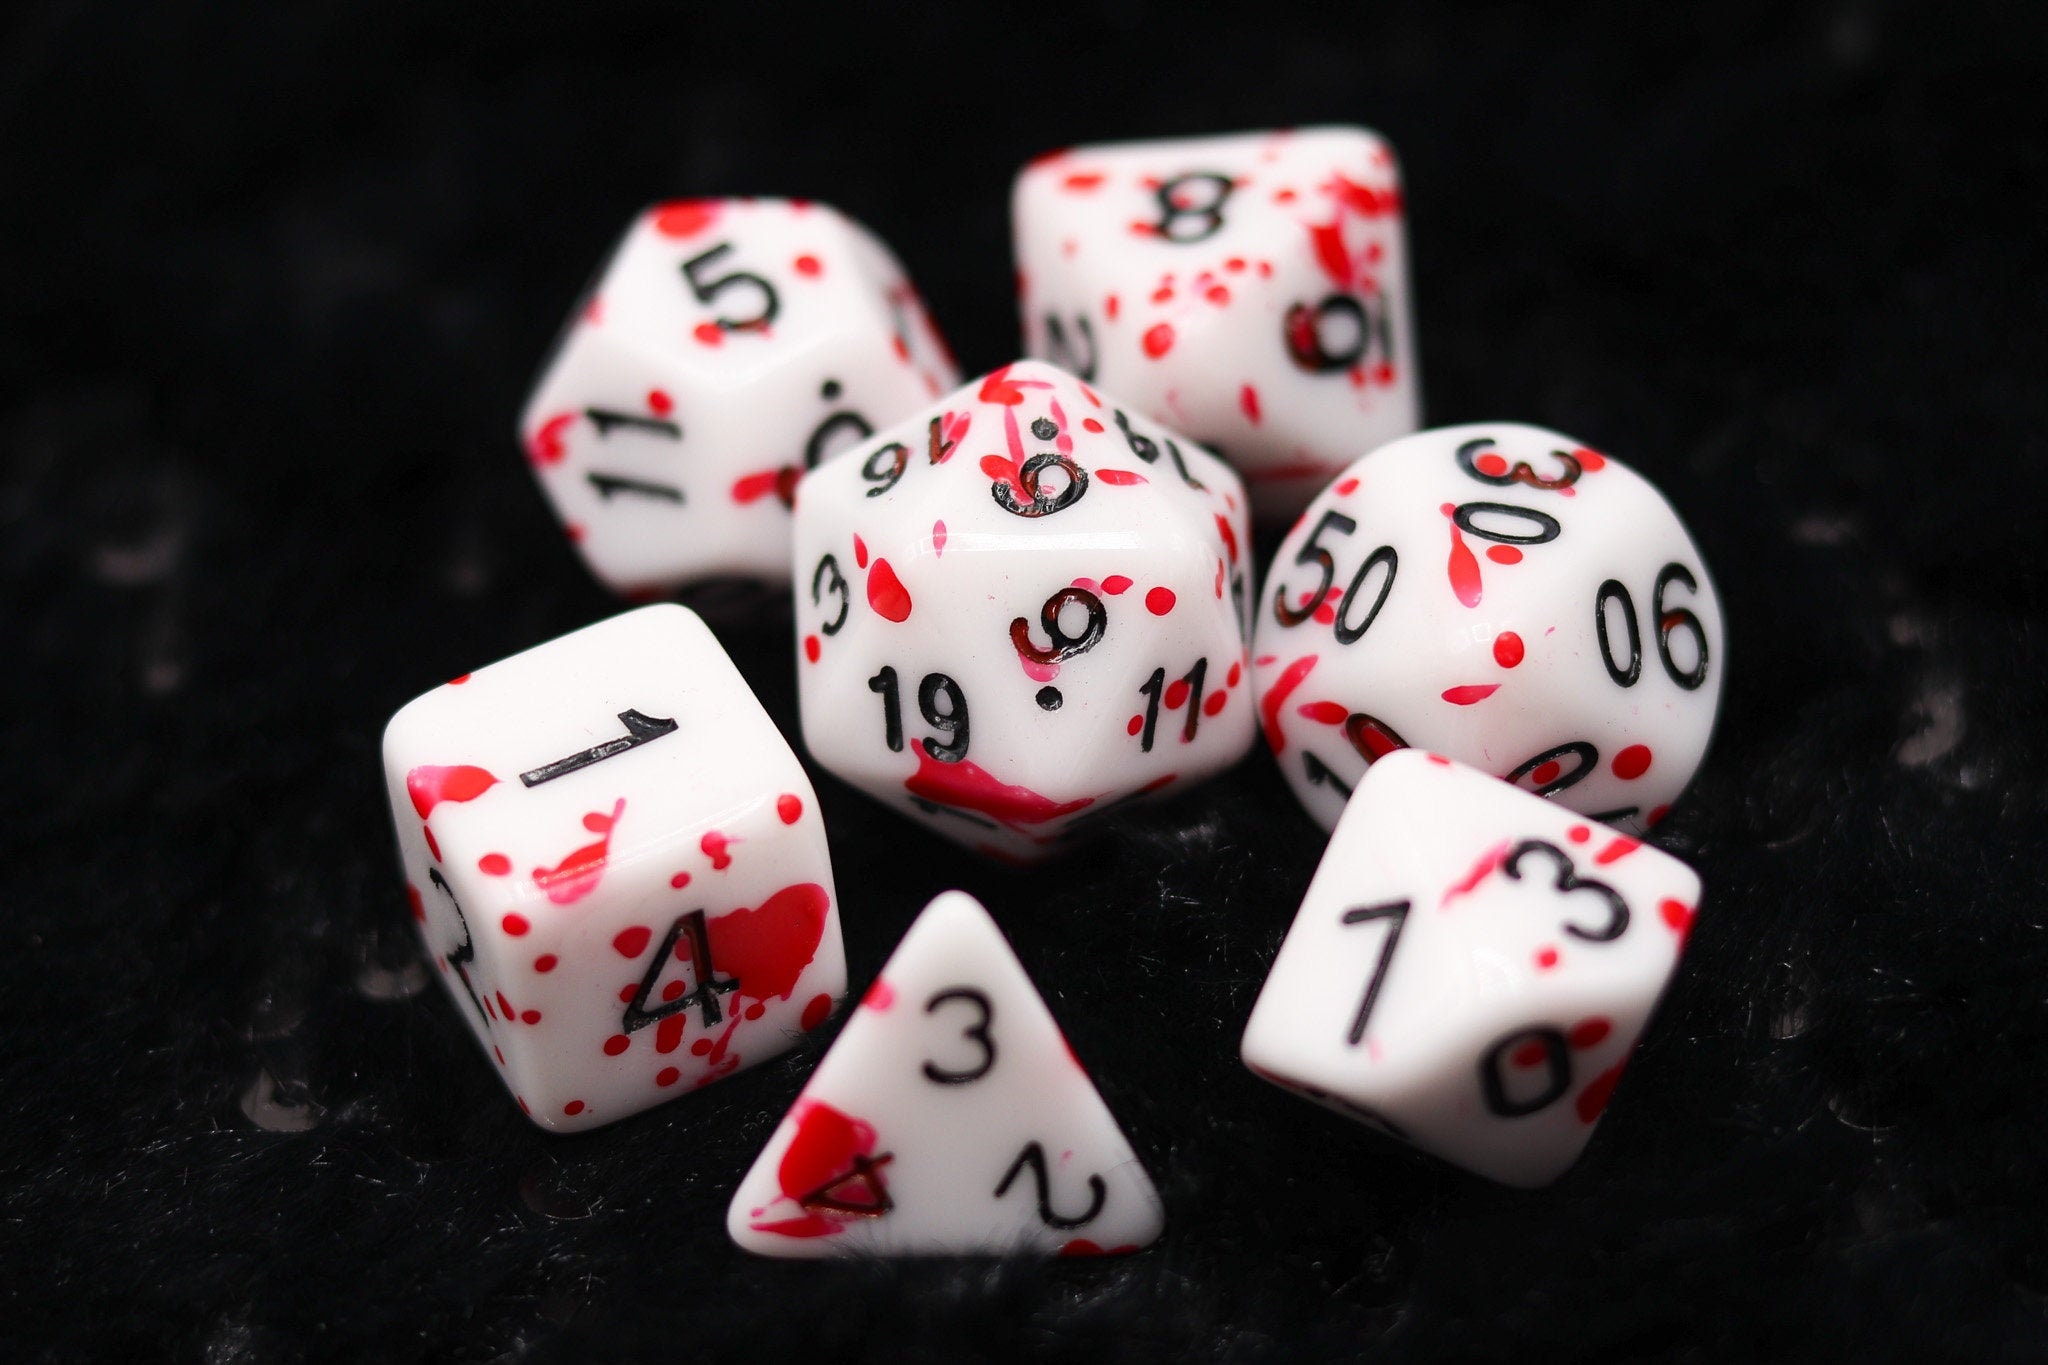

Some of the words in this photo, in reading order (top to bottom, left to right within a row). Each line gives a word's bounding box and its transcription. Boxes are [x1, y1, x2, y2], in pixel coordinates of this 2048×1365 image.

[1156, 169, 1232, 243] 8
[681, 241, 781, 331] 5
[584, 407, 685, 505] 11
[812, 553, 851, 636] 3
[1274, 510, 1398, 645] 50
[519, 708, 679, 788] 1
[868, 665, 970, 763] 19
[1138, 657, 1208, 753] 11
[1504, 838, 1631, 943] 3
[623, 909, 740, 1034] 4
[1341, 900, 1411, 1046] 7
[922, 986, 997, 1085] 3
[1478, 1023, 1572, 1120] 0
[801, 1151, 895, 1217] 4
[993, 1139, 1107, 1229] 2
